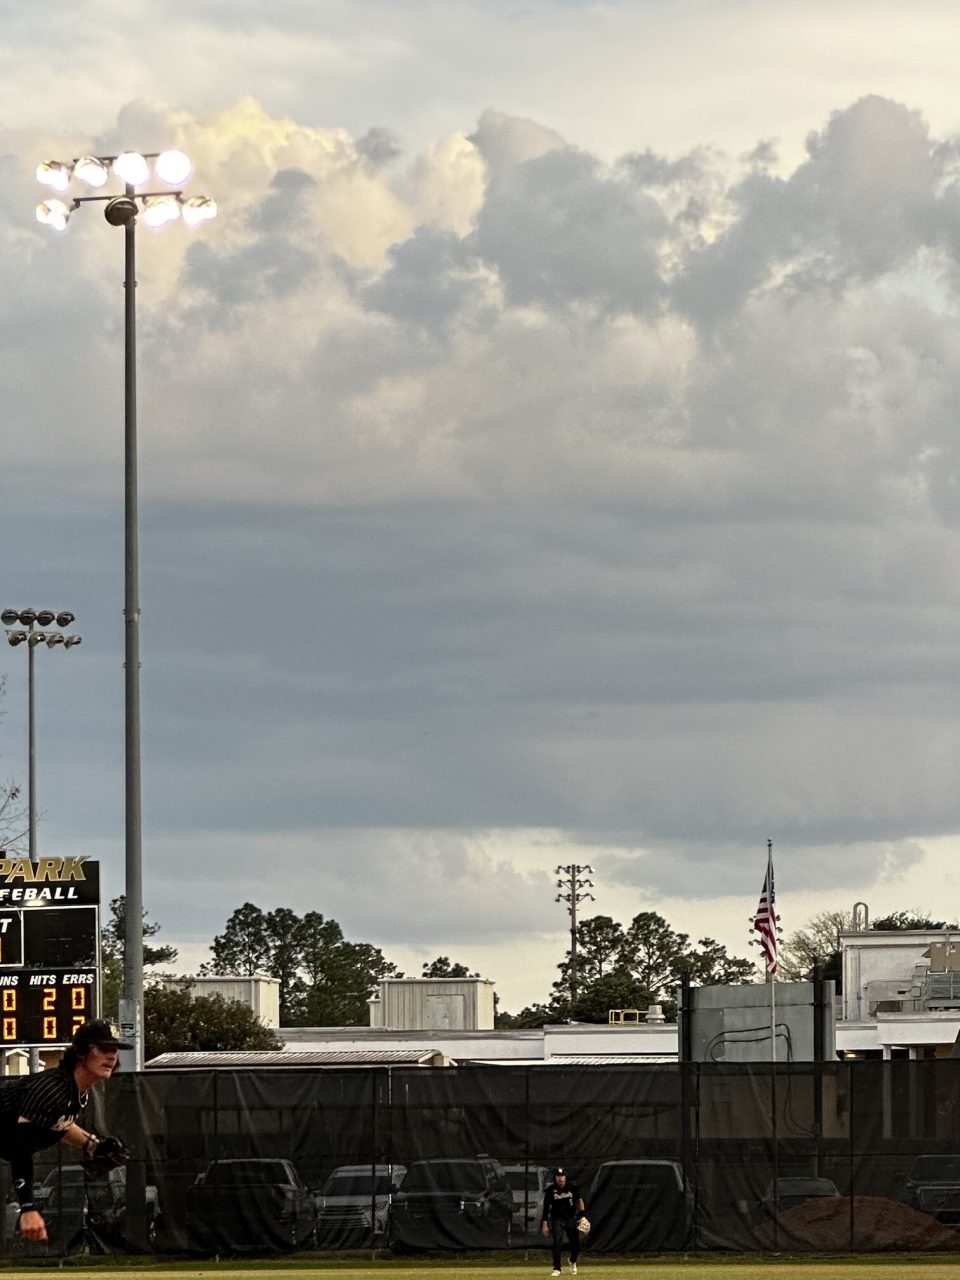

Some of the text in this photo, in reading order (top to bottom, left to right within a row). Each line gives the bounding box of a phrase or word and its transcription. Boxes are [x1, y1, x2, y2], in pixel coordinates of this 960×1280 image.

[30, 975, 57, 985] HITS
[63, 973, 94, 984] ERRS
[3, 989, 16, 1012] 0
[43, 988, 56, 1010] 2
[72, 988, 85, 1009] 0
[3, 1017, 16, 1040] 0
[43, 1016, 56, 1039] 0
